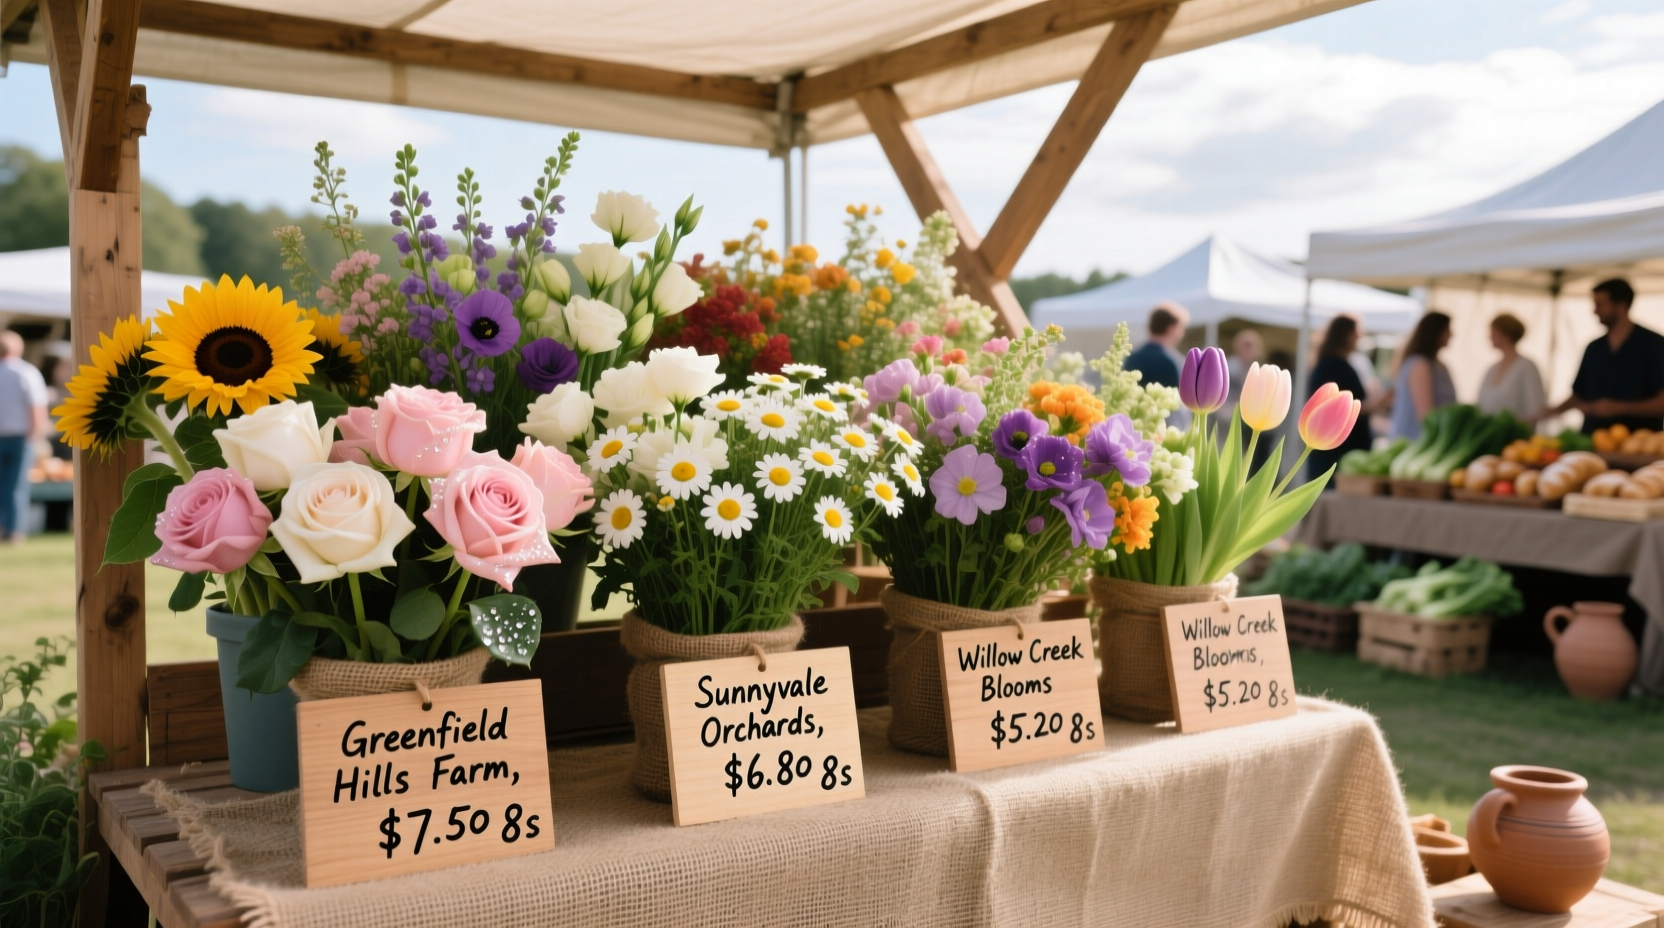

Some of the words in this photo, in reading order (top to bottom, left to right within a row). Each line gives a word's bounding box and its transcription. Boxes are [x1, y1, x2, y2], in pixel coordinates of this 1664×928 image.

[1181, 616, 1231, 641] Willow
[1237, 610, 1278, 635] Creek
[957, 641, 1023, 672] Willow
[1029, 635, 1084, 664] Creek
[694, 666, 829, 715] Sunnyvale
[981, 673, 1052, 702] Blooms
[1203, 678, 1261, 713] $5.20
[1268, 680, 1289, 708] 8s
[341, 706, 508, 758] Greenfield
[700, 705, 824, 748] Orchards,
[990, 710, 1063, 750] $5.20
[1070, 712, 1096, 744] 8s
[333, 761, 409, 804] Hills
[432, 753, 520, 790] Farm,
[724, 750, 812, 798] $6.80
[820, 754, 853, 791] 8s
[379, 805, 490, 859] $7.50
[501, 803, 540, 843] 8s
